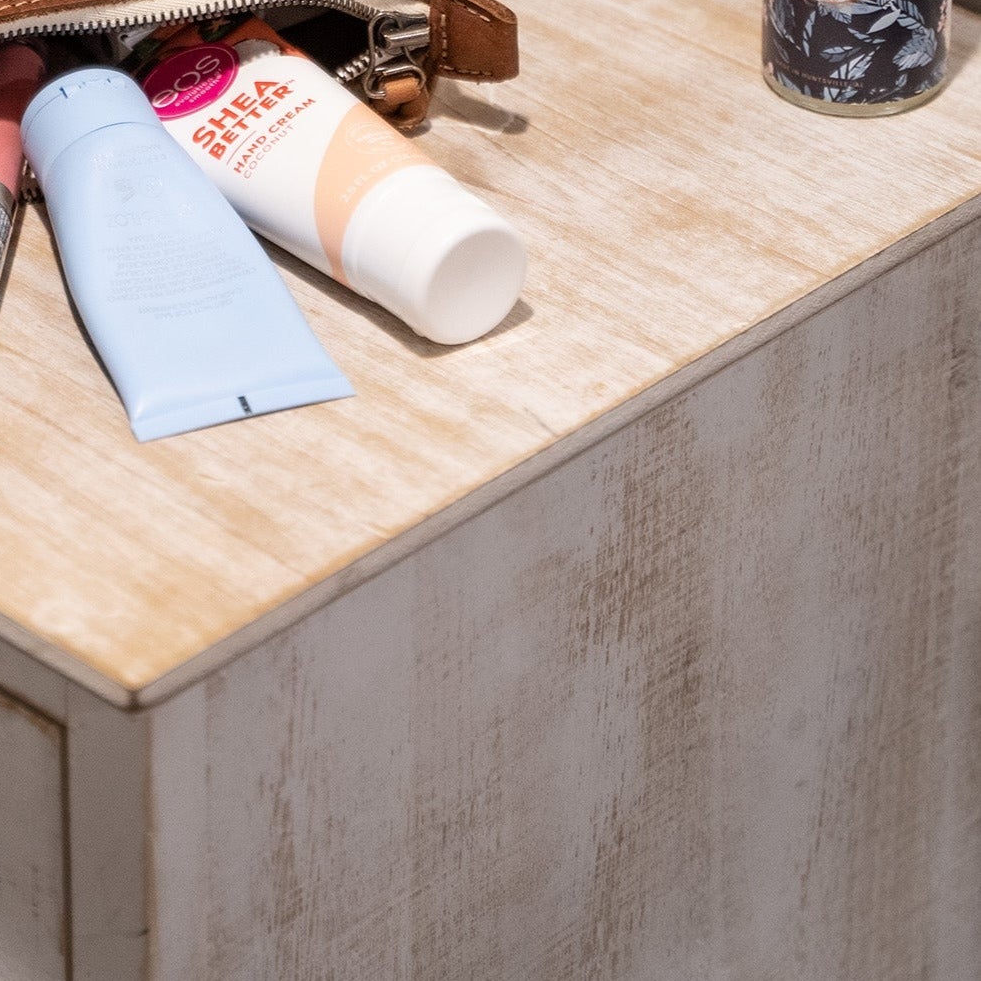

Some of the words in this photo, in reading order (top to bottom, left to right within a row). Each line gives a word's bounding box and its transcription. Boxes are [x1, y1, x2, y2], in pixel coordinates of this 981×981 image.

[152, 55, 220, 109] eos
[192, 80, 280, 150] SHEA
[233, 135, 267, 174] HAND
[268, 98, 316, 134] CREAM
[243, 124, 294, 179] COCONUT
